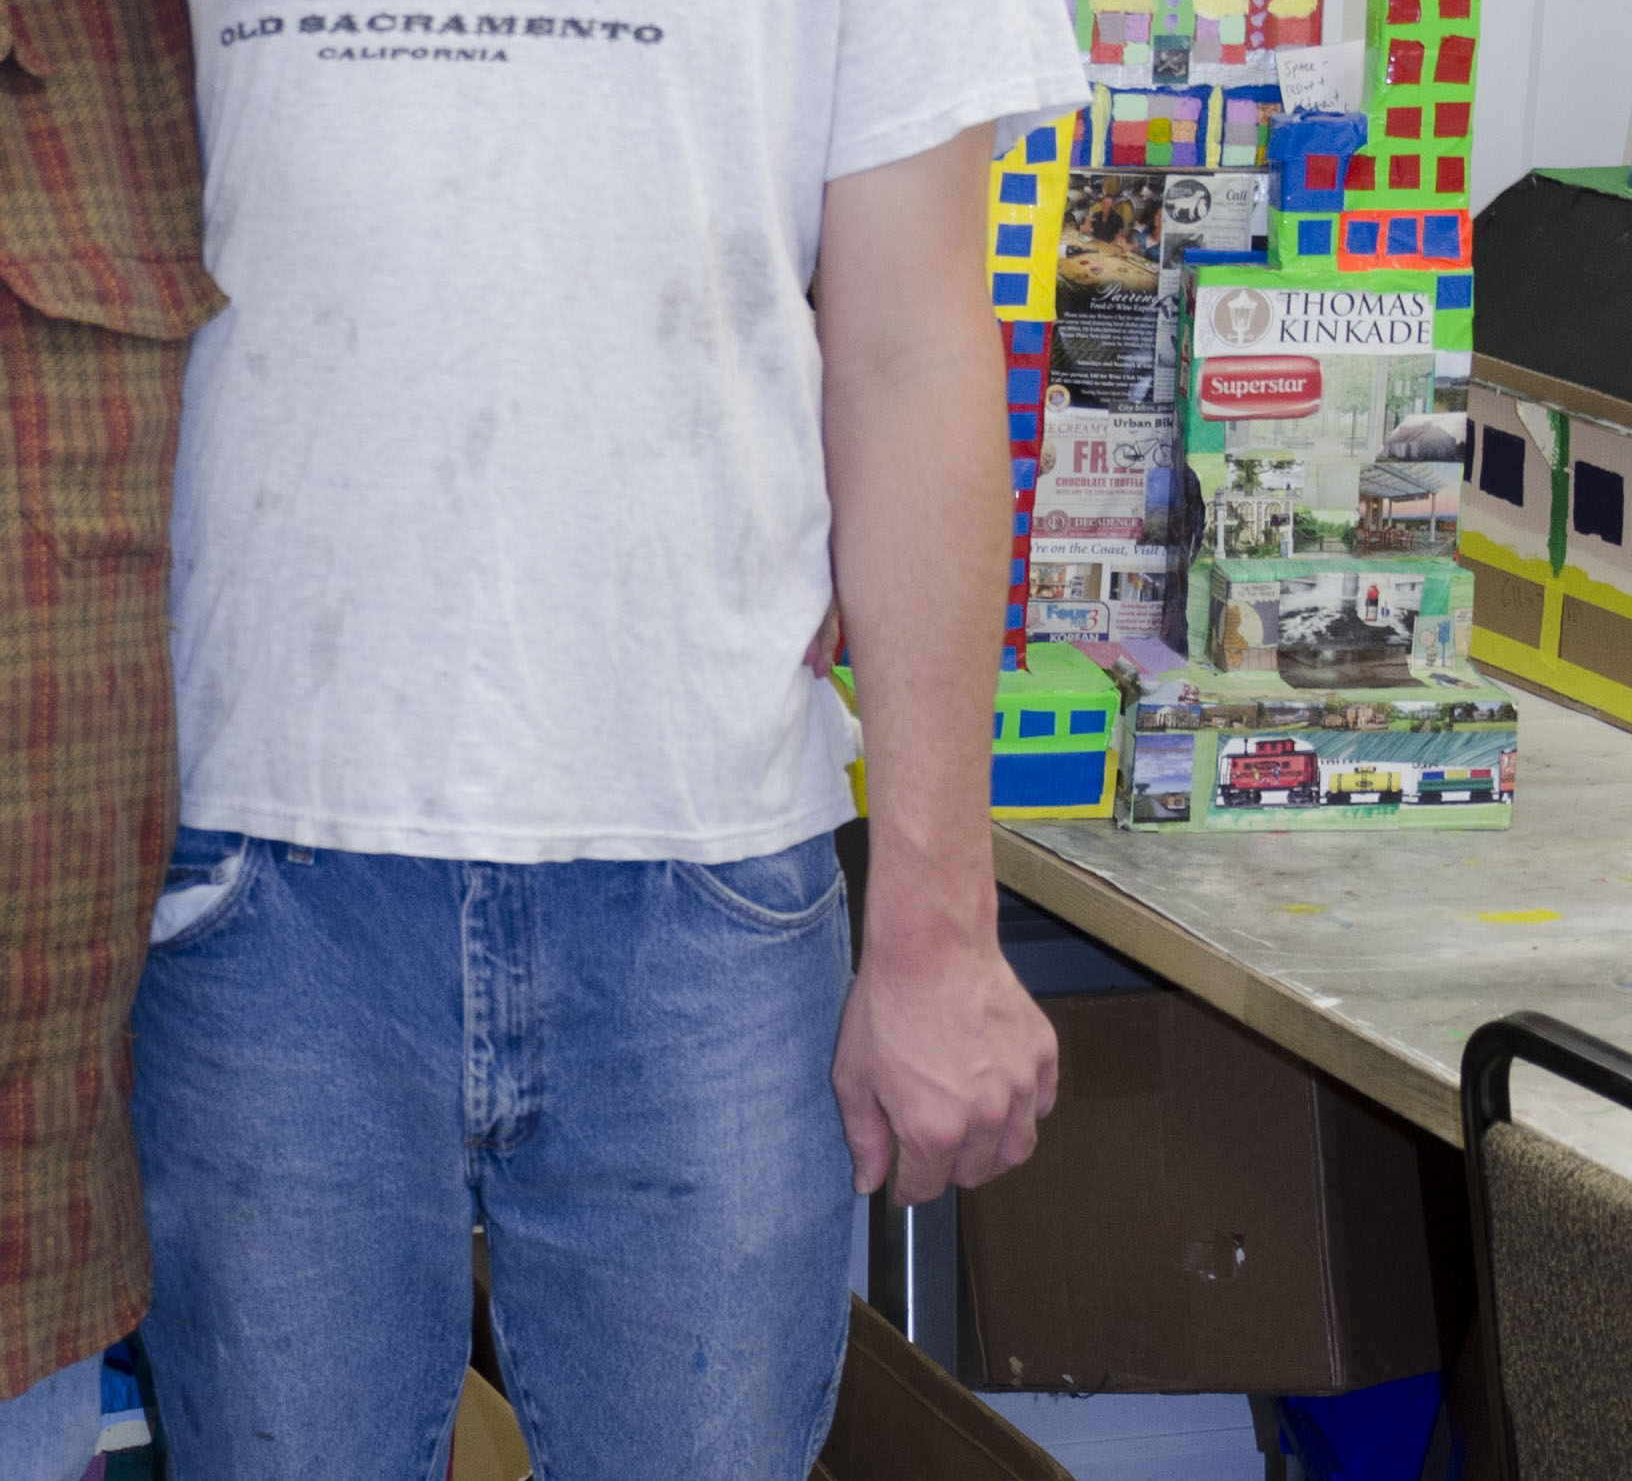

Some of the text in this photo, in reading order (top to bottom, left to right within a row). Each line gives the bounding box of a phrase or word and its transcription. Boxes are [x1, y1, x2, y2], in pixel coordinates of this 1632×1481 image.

[220, 12, 666, 47] OLD SACRAMENTO
[317, 46, 510, 63] CALIFORNIA
[1279, 291, 1425, 318] THOMAS
[1279, 319, 1432, 345] KINKADE
[1210, 376, 1308, 399] Superstar
[1113, 418, 1152, 428] Urban
[1055, 476, 1106, 487] CHOCOLATE
[1074, 518, 1138, 528] DECADENCE
[1050, 545, 1066, 554] on
[1069, 542, 1088, 554] the
[1091, 543, 1129, 556] Coast,
[1049, 633, 1099, 643] KOREAN
